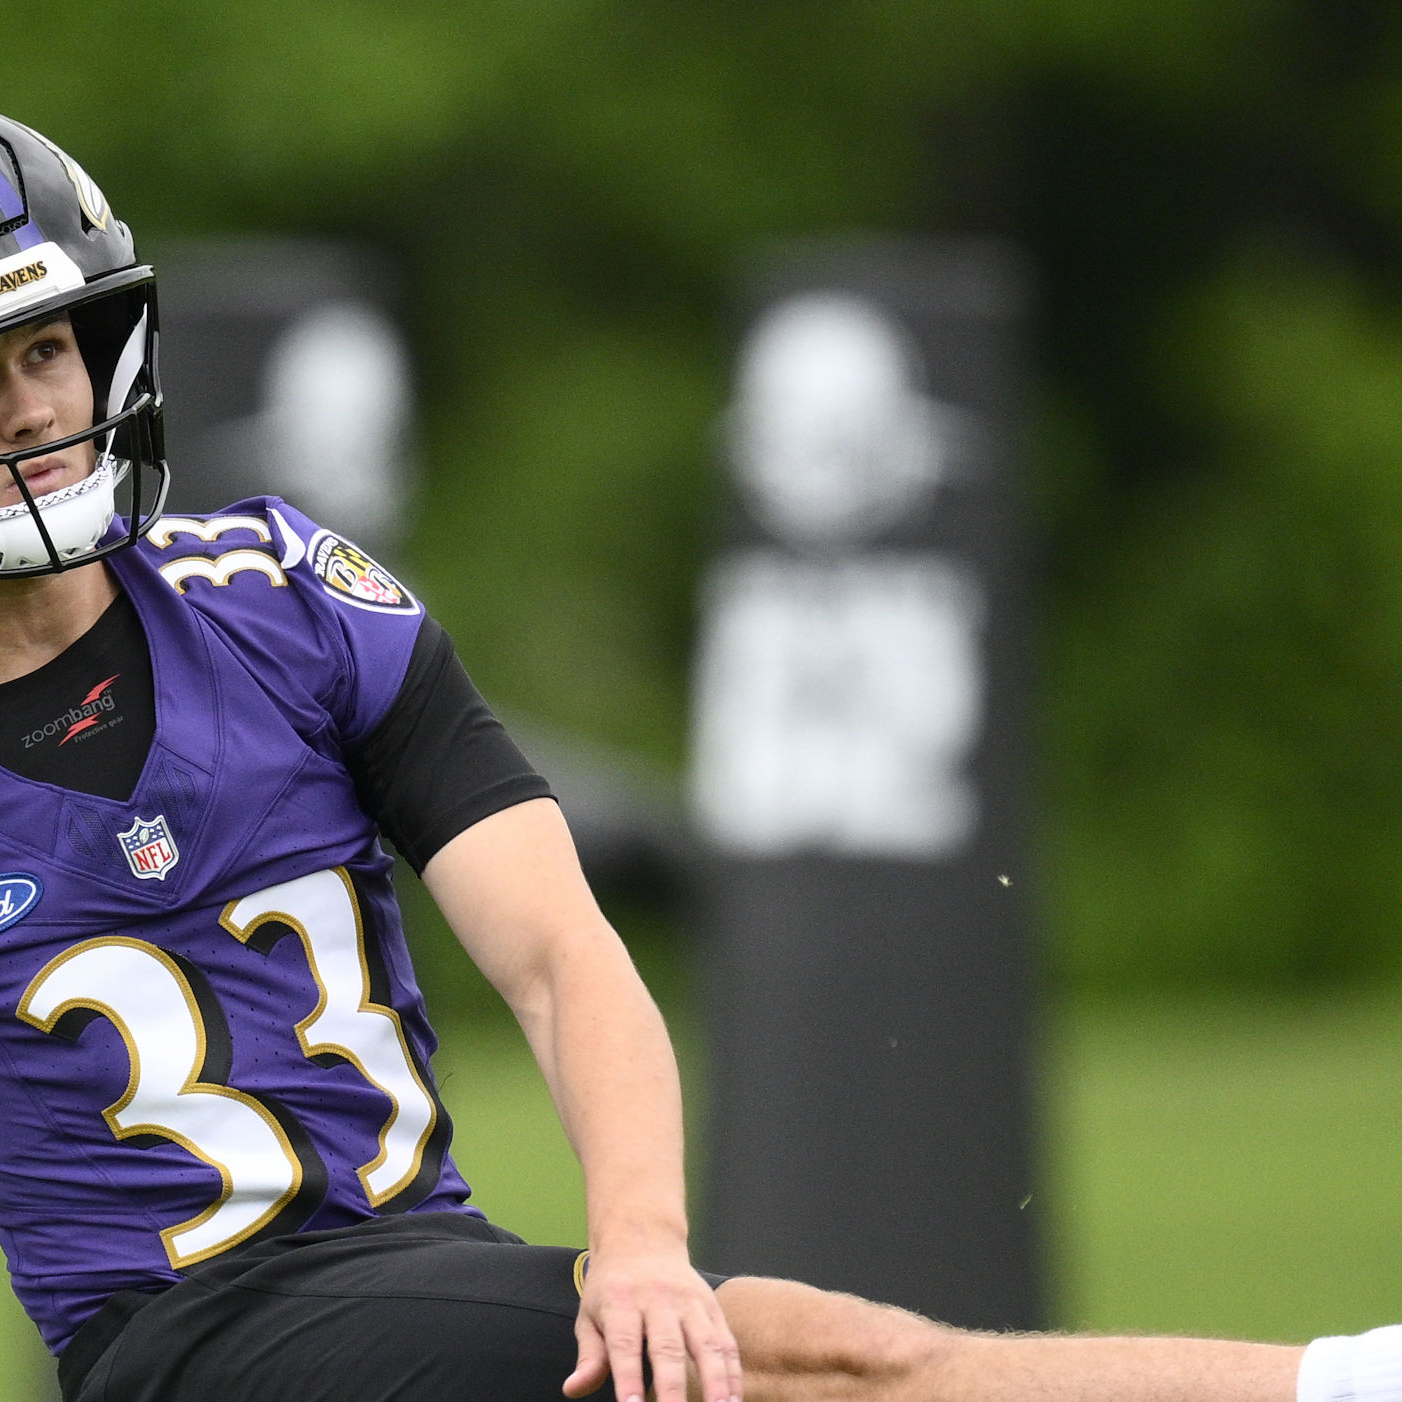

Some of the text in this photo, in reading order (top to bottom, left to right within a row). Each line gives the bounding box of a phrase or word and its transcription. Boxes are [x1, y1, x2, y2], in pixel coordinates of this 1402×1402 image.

[146, 515, 289, 595] 33
[314, 536, 339, 578] RAVENS
[21, 694, 116, 749] zoombang
[73, 715, 124, 743] Protective gear
[133, 841, 173, 872] NFL
[16, 866, 442, 1270] 33
